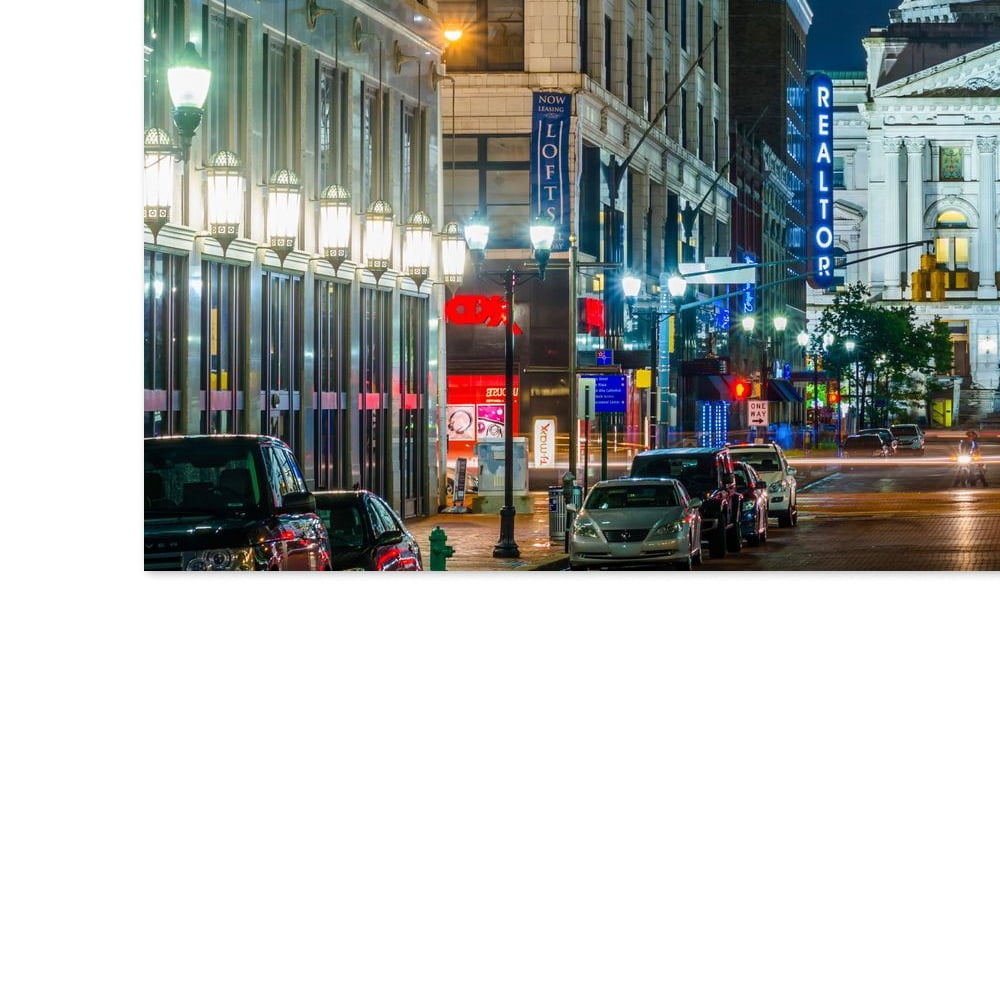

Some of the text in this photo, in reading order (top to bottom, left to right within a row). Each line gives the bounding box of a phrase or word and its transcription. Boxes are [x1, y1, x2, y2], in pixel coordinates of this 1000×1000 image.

[538, 95, 566, 105] NOW
[538, 105, 565, 113] LEASING
[542, 123, 558, 222] LOFTS
[815, 86, 833, 276] REALTOR
